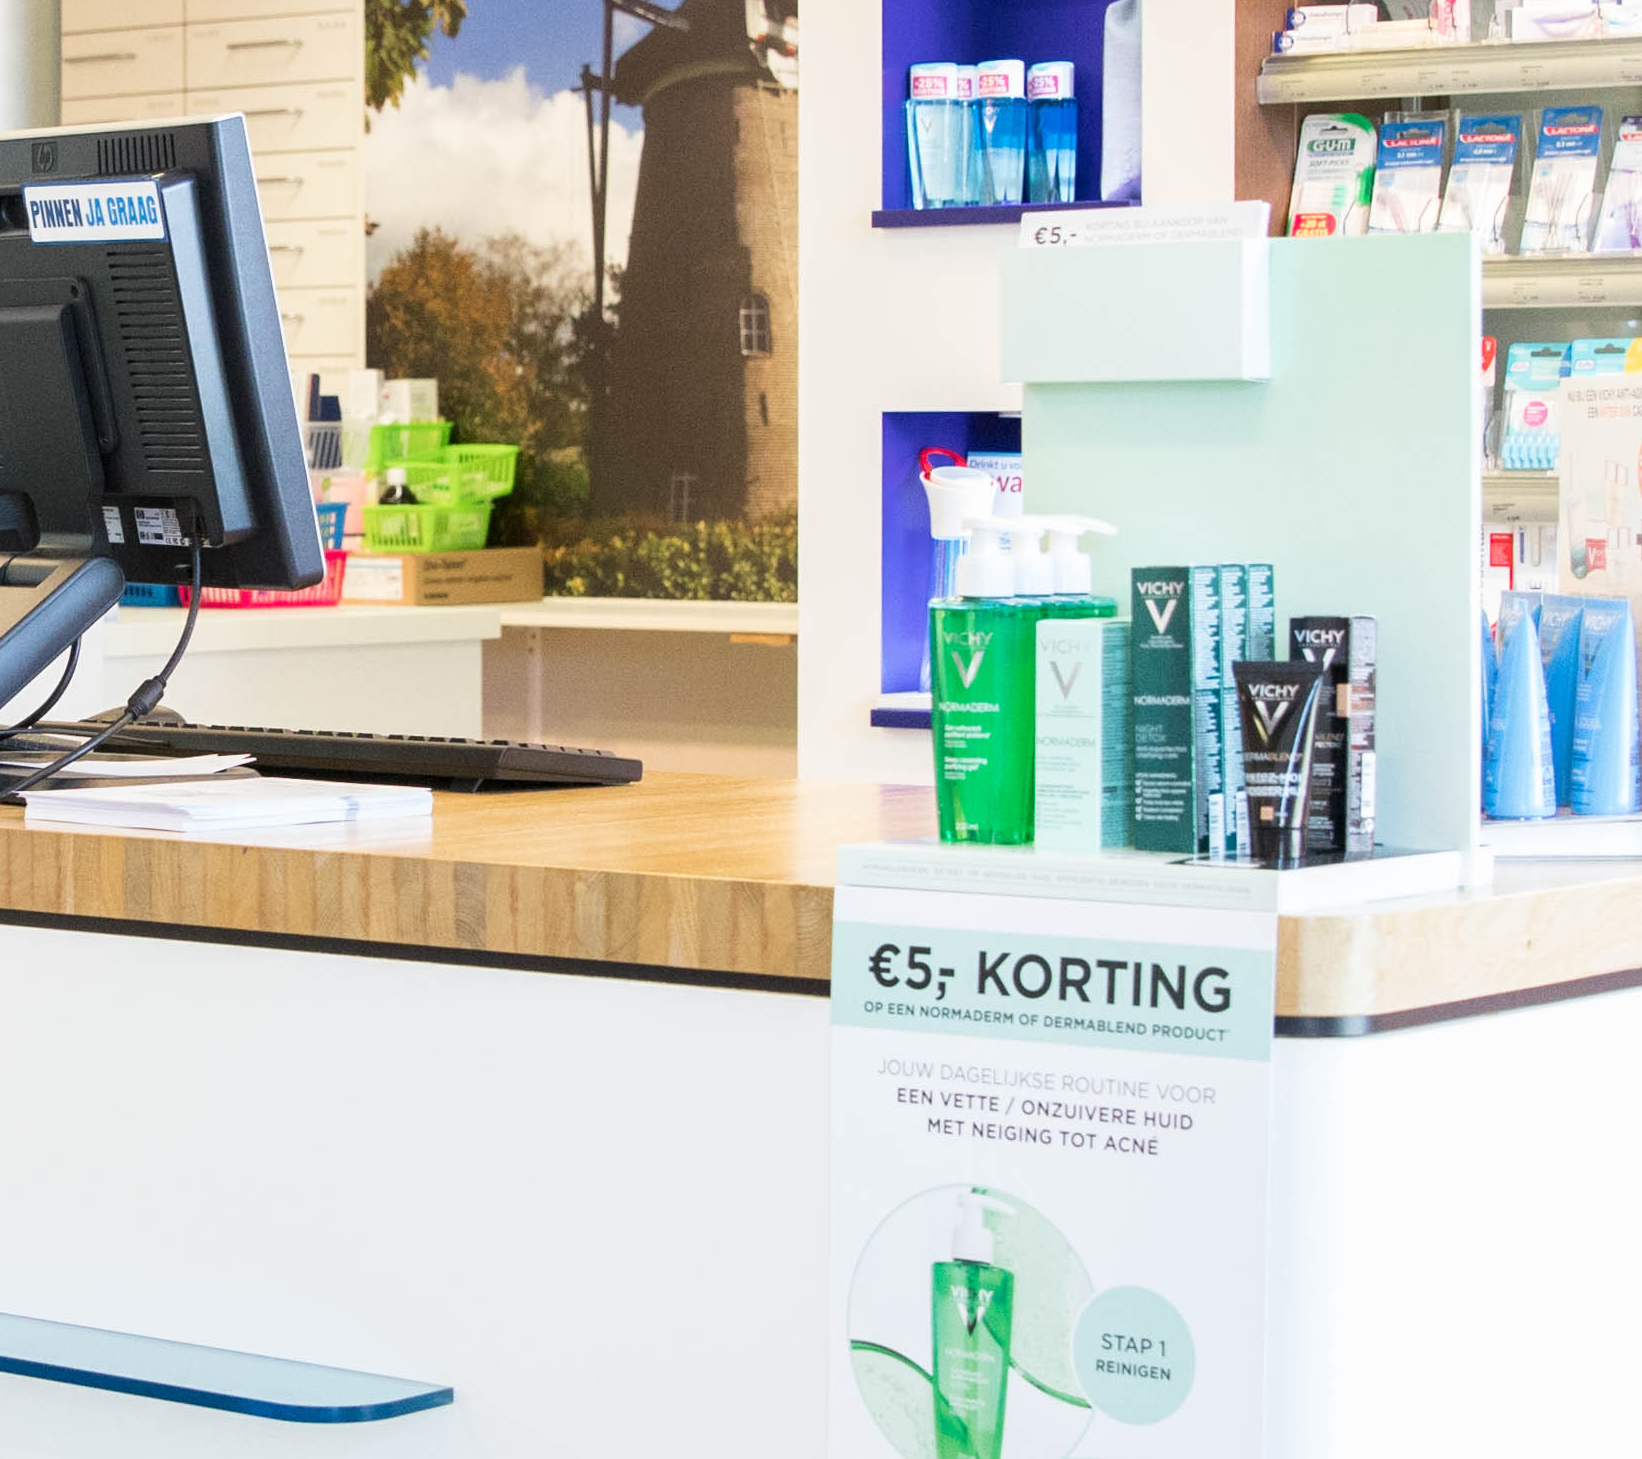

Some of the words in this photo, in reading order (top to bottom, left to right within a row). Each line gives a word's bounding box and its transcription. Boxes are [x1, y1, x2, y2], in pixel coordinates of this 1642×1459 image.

[30, 198, 83, 228] PINNEN
[85, 198, 104, 226] JA
[107, 196, 158, 225] GRAAG
[970, 459, 999, 469] Drinkt
[1137, 581, 1184, 595] VICHY
[944, 631, 994, 647] VICHY
[1294, 629, 1345, 643] VICHY
[1248, 683, 1300, 697] VICHY
[939, 702, 1000, 713] NORMADERM
[1134, 695, 1191, 706] NORMADERM
[1036, 736, 1095, 748] NORMADERM
[869, 943, 956, 1001] €5,-
[976, 950, 1232, 1014] KORTING
[864, 1000, 884, 1015] OP
[888, 1002, 915, 1016] EEN
[919, 1005, 1014, 1026] NORMADERM
[1019, 1012, 1040, 1027] OF
[1044, 1013, 1147, 1037] DERMABLEND
[877, 1059, 934, 1081] JOUW
[940, 1063, 1055, 1091] DAGELIJKSE
[1061, 1073, 1149, 1100] ROUTINE
[1156, 1083, 1216, 1105] VOOR
[897, 1088, 933, 1106] EEN
[940, 1091, 1000, 1112] VETTE
[1021, 1098, 1137, 1128] ONZUIVERE
[1144, 1109, 1194, 1131] HUID
[927, 1119, 964, 1139] MET
[971, 1123, 1053, 1147] NEIGING
[1059, 1131, 1097, 1151] TOT
[1101, 1333, 1152, 1356] STAP
[1159, 1339, 1167, 1357] 1
[1096, 1359, 1171, 1382] REINIGEN
